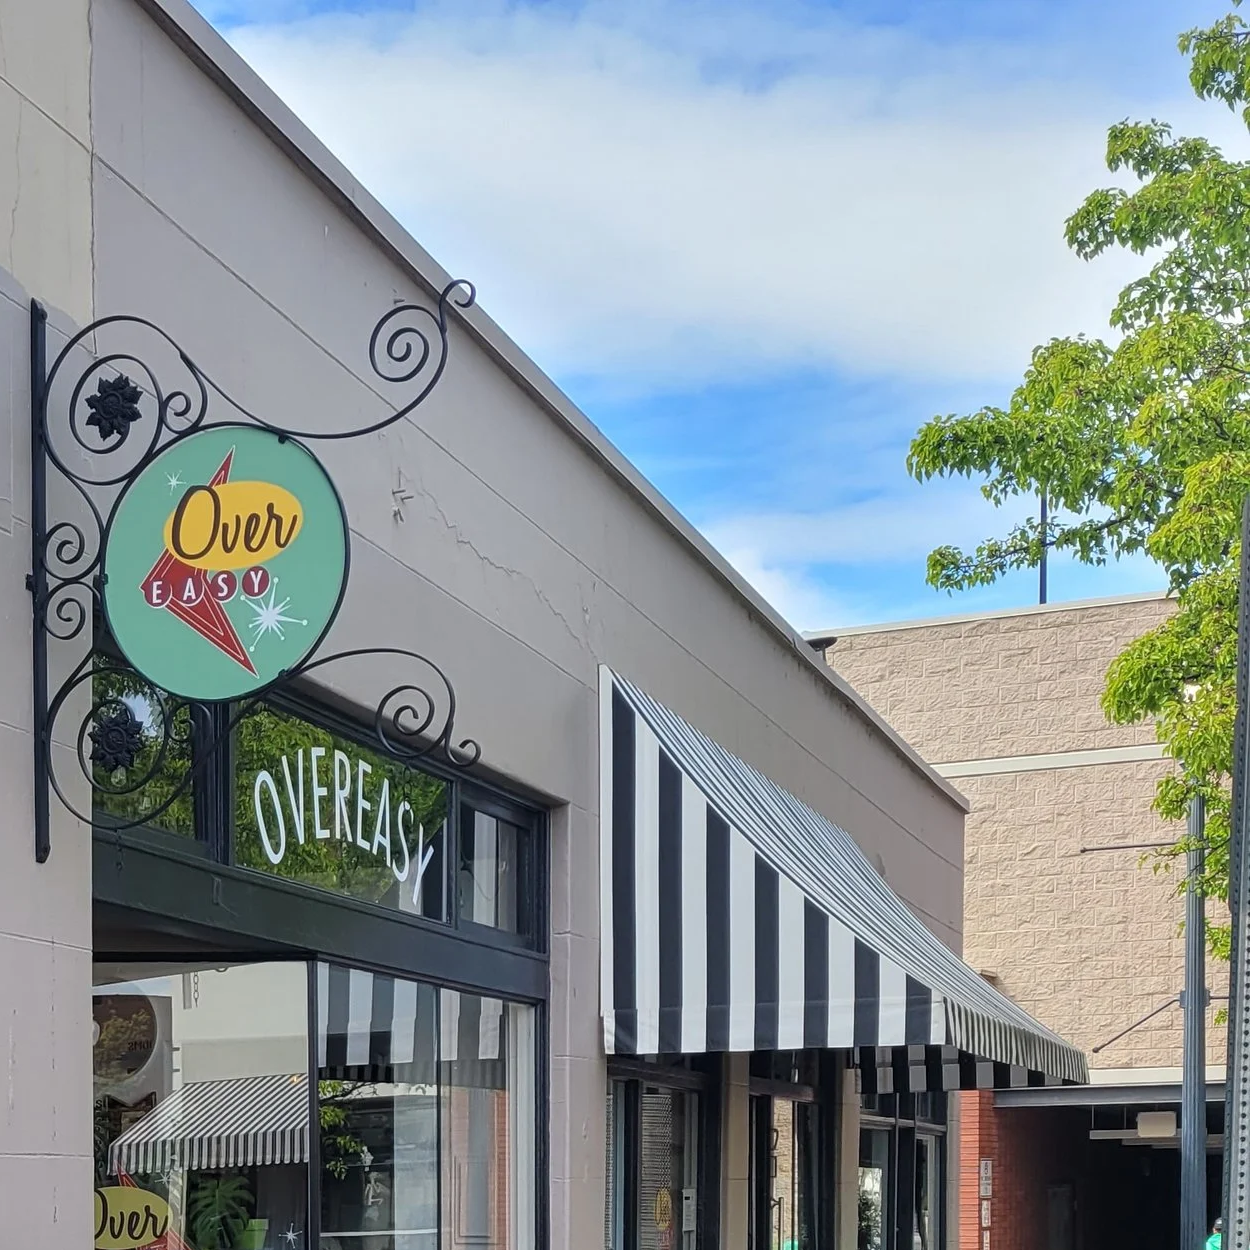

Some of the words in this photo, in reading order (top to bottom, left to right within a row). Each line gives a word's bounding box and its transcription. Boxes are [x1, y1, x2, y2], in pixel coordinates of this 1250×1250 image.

[171, 484, 299, 561] Over
[151, 568, 265, 605] EASY
[254, 746, 435, 906] OVEREASY
